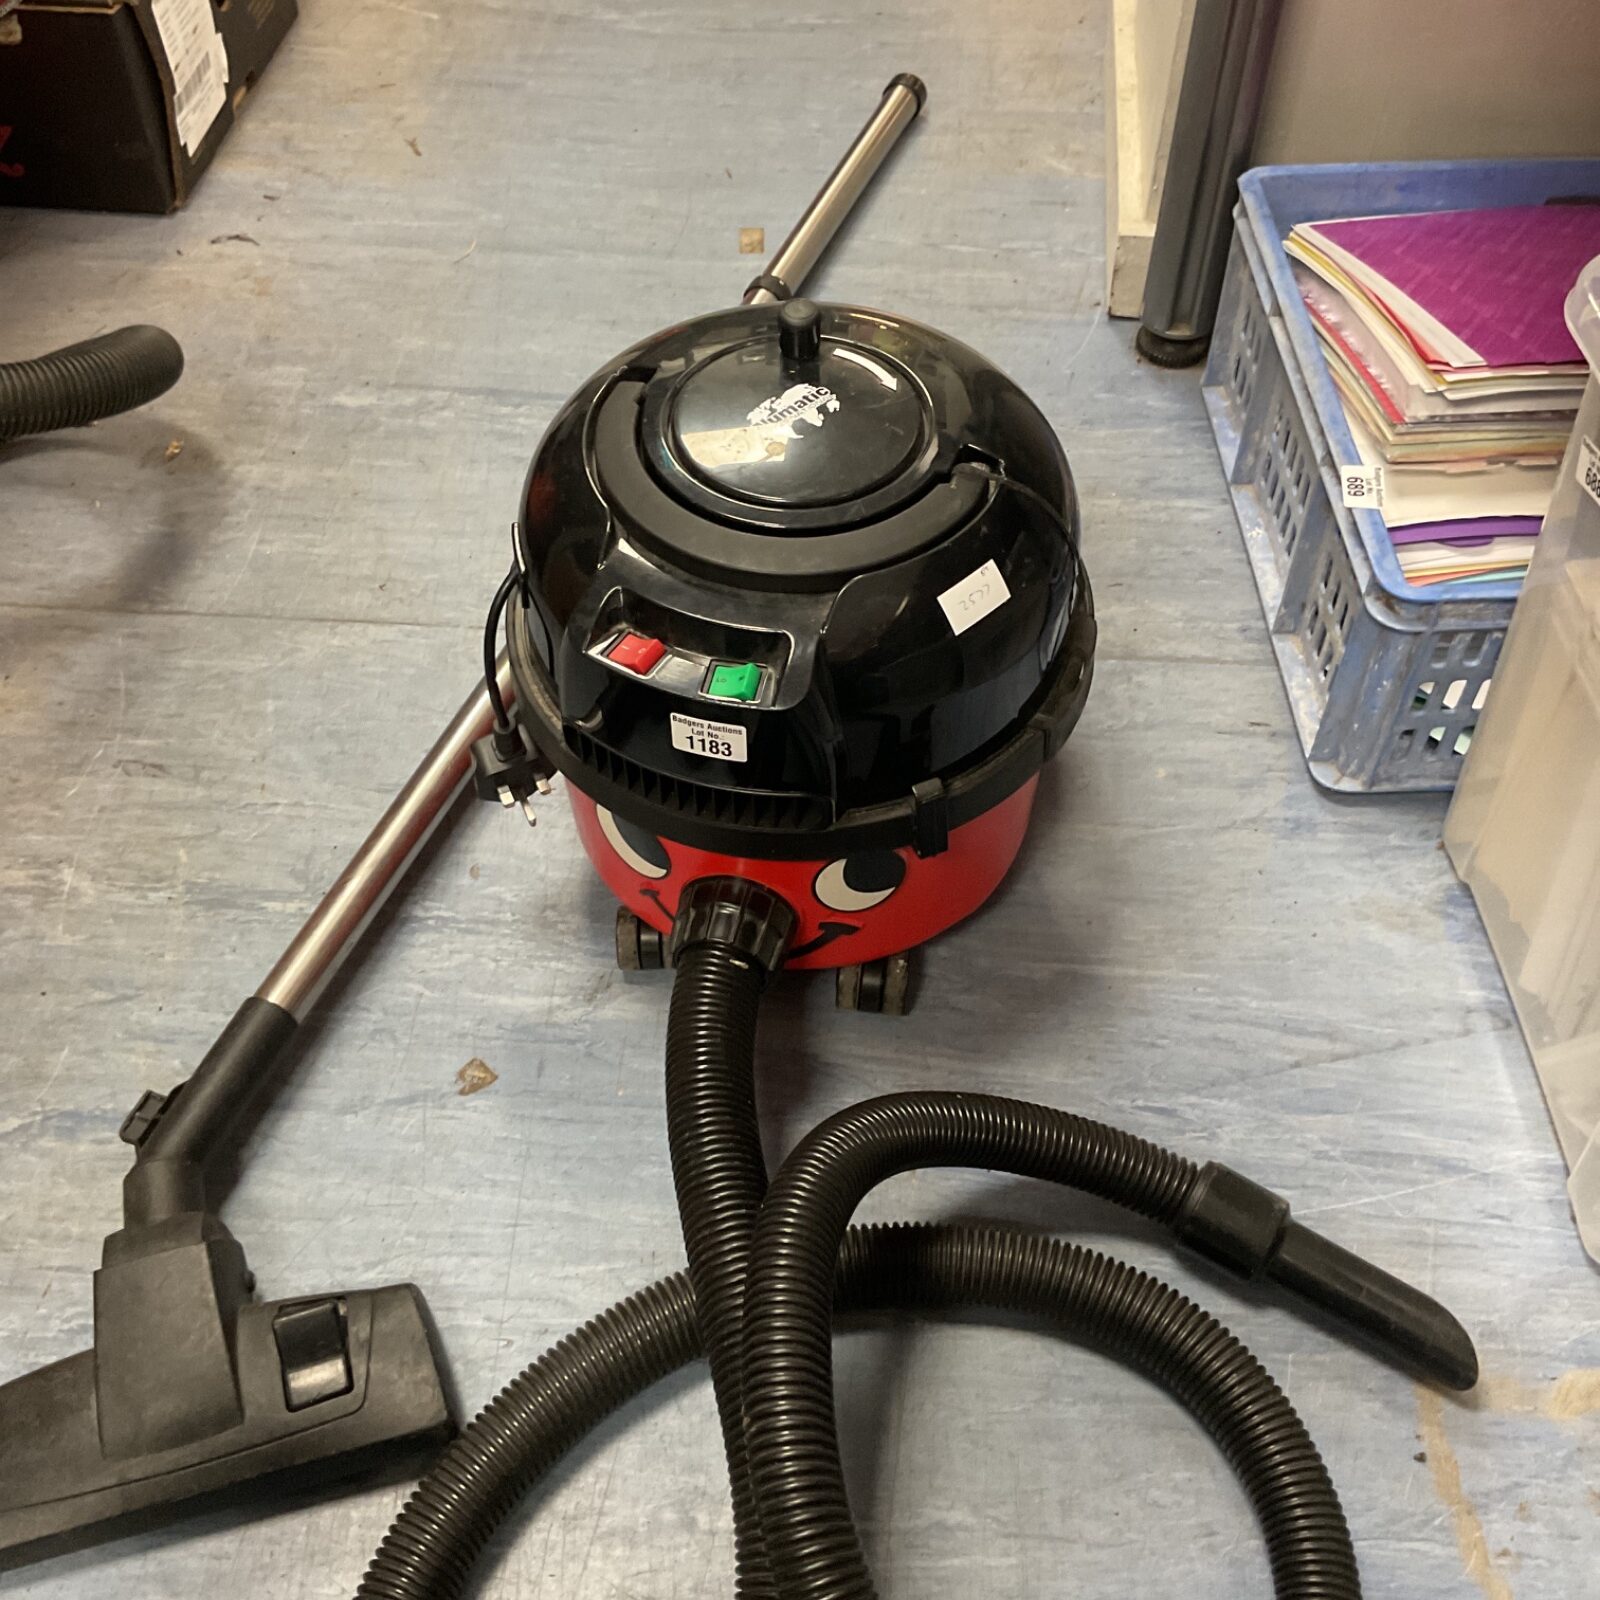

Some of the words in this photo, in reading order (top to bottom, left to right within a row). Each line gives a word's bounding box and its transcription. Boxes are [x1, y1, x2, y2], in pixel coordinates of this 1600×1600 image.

[1346, 476, 1365, 497] 689
[672, 714, 704, 729] Badgers
[707, 723, 743, 736] Auctions
[691, 727, 705, 737] Lot
[685, 735, 732, 757] 1183
